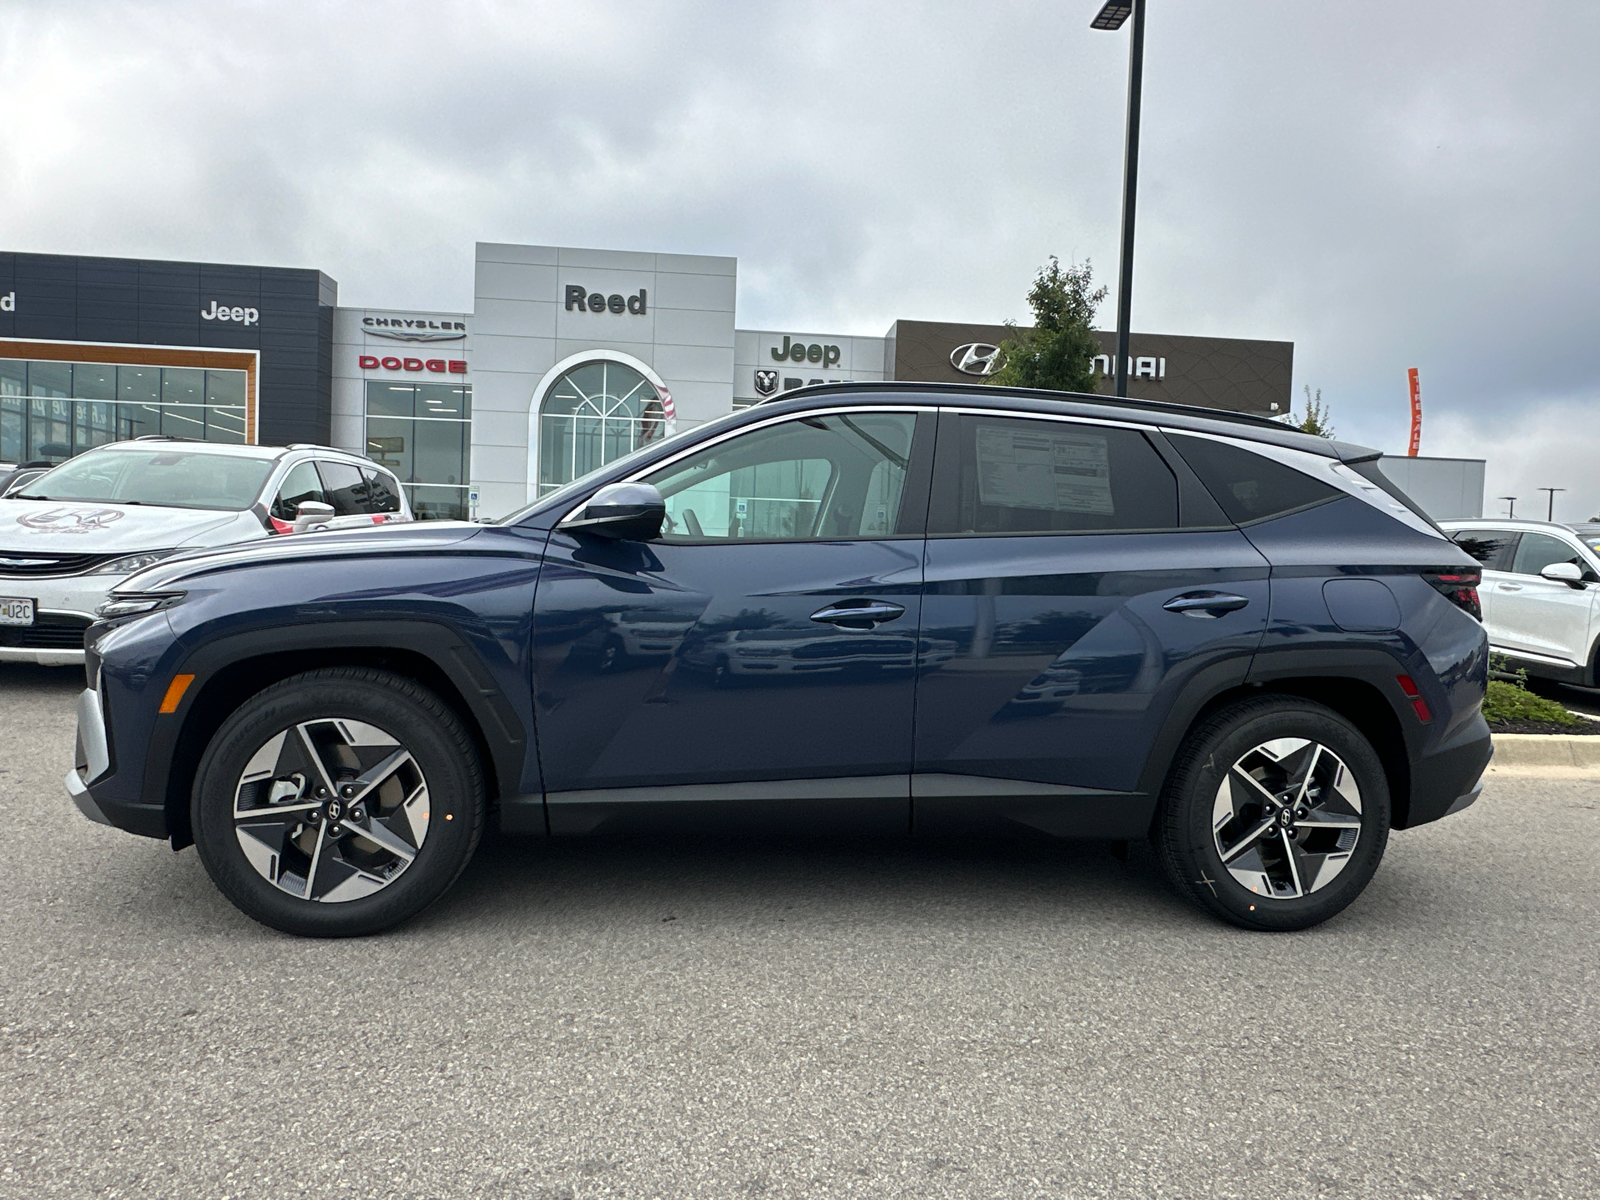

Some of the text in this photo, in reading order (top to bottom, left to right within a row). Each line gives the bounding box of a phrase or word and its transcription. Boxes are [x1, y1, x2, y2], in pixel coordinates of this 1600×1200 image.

[565, 284, 647, 315] Reed
[201, 300, 259, 326] Jeep
[362, 317, 466, 331] CHRYSLER
[359, 355, 468, 374] DODGE
[771, 335, 841, 369] Jeep
[1412, 375, 1422, 450] TIRE SALE
[7, 604, 31, 619] U2C
